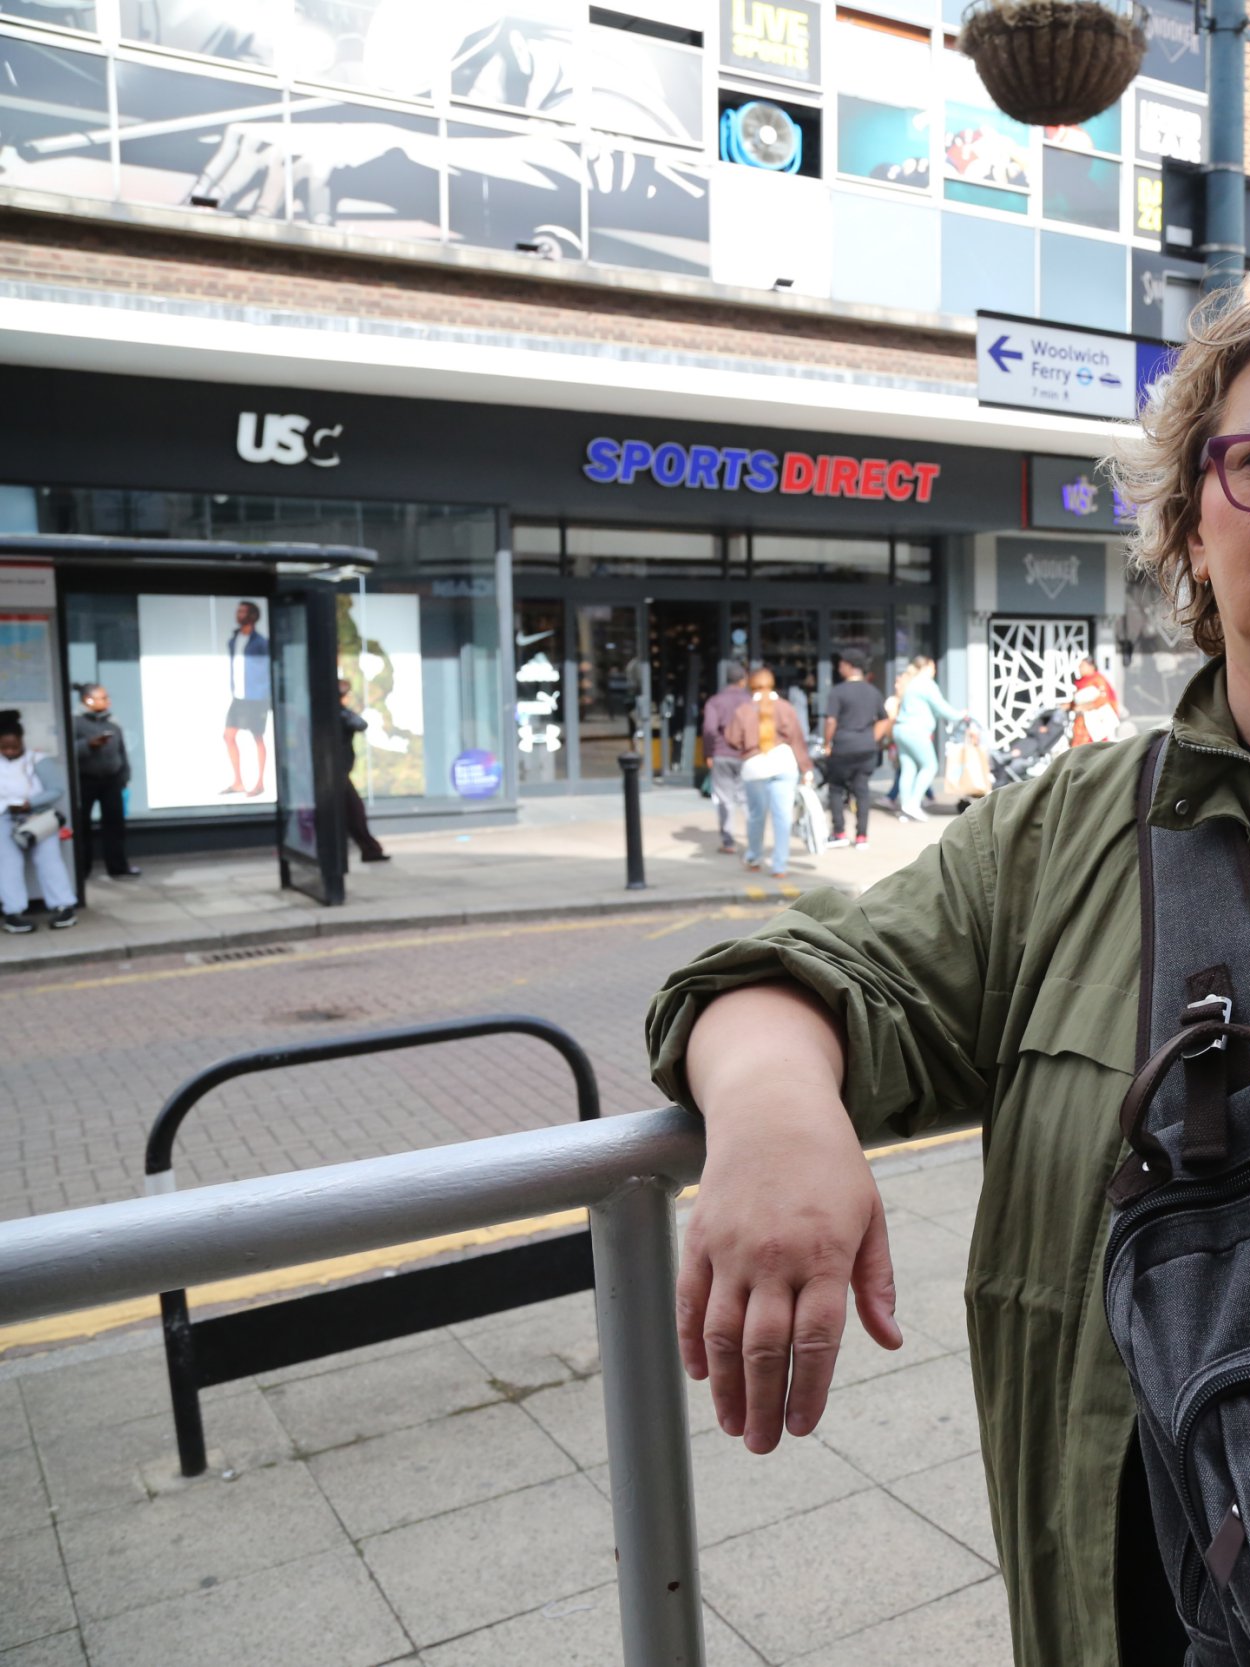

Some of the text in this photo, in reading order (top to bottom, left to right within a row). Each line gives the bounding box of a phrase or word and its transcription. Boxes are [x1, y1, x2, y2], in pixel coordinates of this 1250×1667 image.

[731, 0, 809, 49] LIVE
[1031, 339, 1110, 367] Woolwich
[1031, 361, 1072, 386] Ferry
[1040, 389, 1059, 400] min
[236, 411, 344, 467] USC
[583, 436, 940, 503] SPORTS DIRECT
